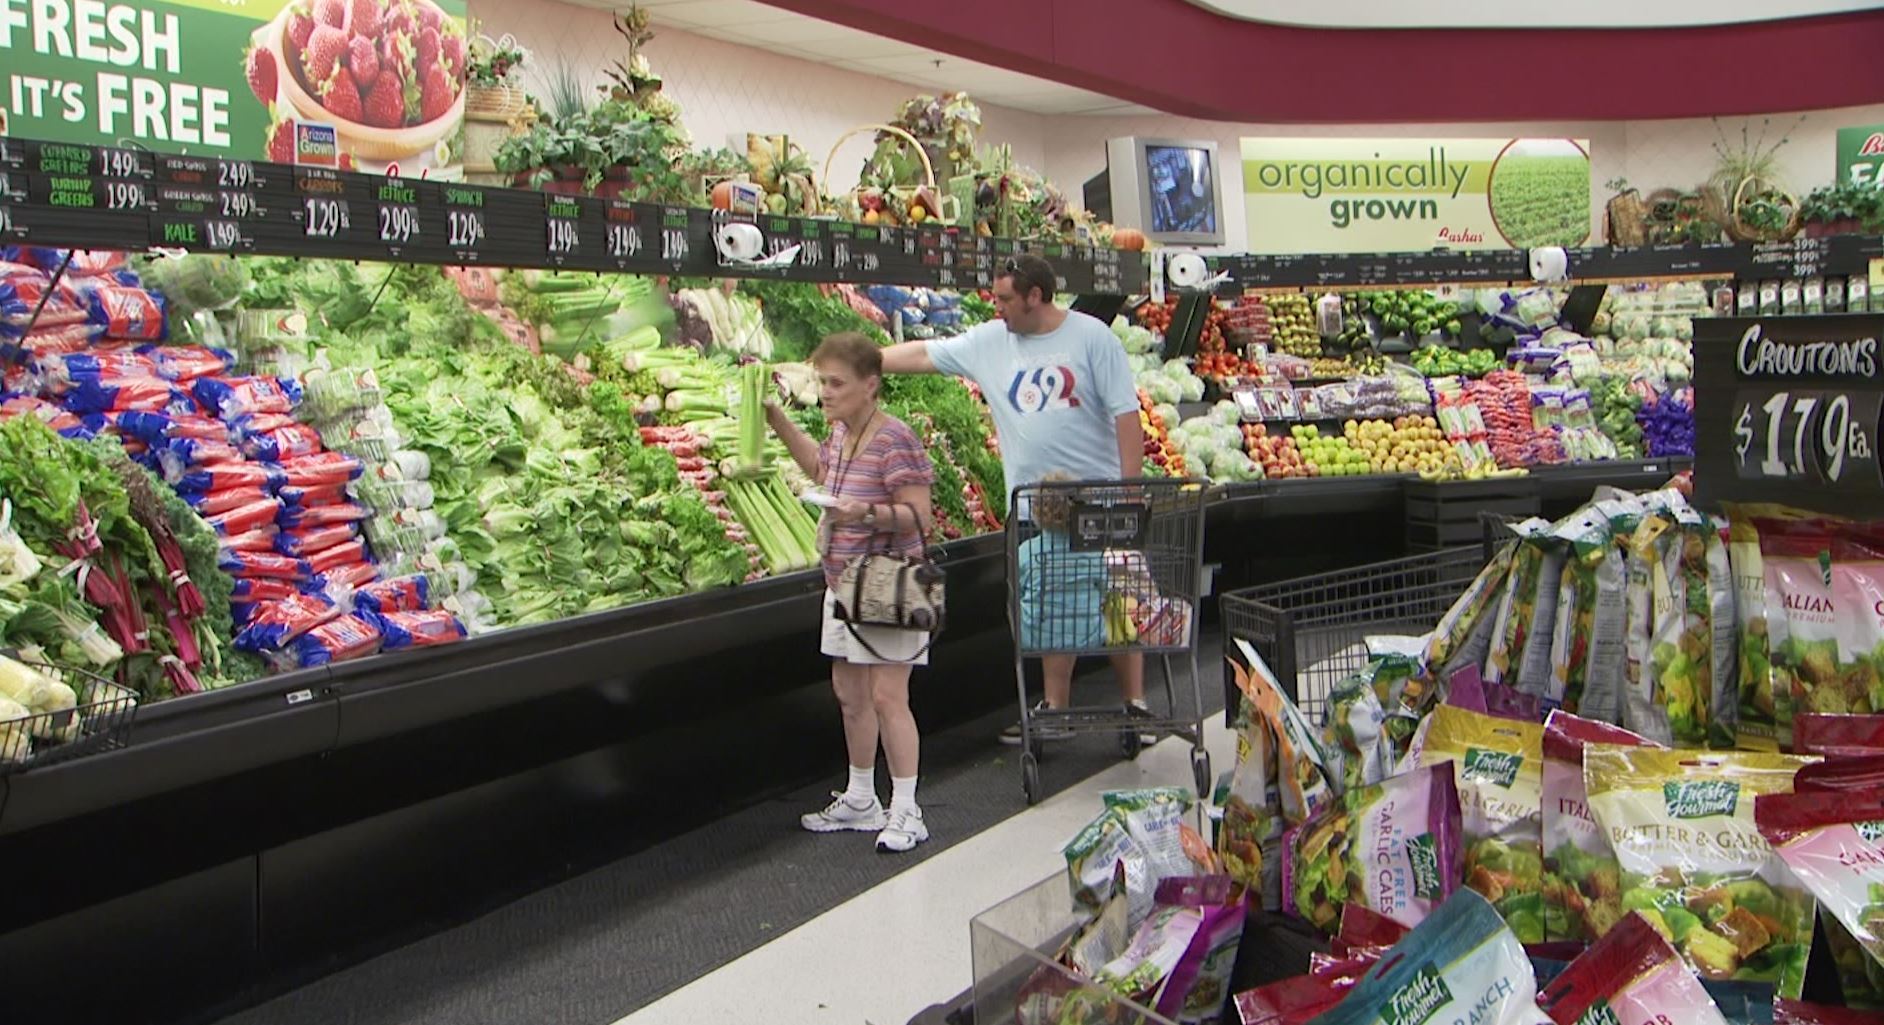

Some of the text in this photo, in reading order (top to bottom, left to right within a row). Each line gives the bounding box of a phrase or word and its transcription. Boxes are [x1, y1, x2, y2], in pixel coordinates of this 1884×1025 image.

[0, 0, 181, 73] FRESH
[10, 71, 231, 147] IT'S FREE
[300, 139, 335, 154] Grown
[301, 126, 333, 142] Arizona
[1259, 146, 1469, 199] organically
[49, 191, 94, 207] GREENS
[379, 186, 416, 204] LETTUCE
[1330, 198, 1438, 228] grown
[164, 223, 196, 242] KALE
[1737, 323, 1878, 377] CROUTONS
[1735, 391, 1851, 482] $1.79
[1783, 592, 1834, 613] ALIAN
[1667, 791, 1734, 818] Gourmet
[1677, 780, 1726, 803] Fresh
[1393, 867, 1406, 910] FREE
[1389, 970, 1433, 1017] Fresh
